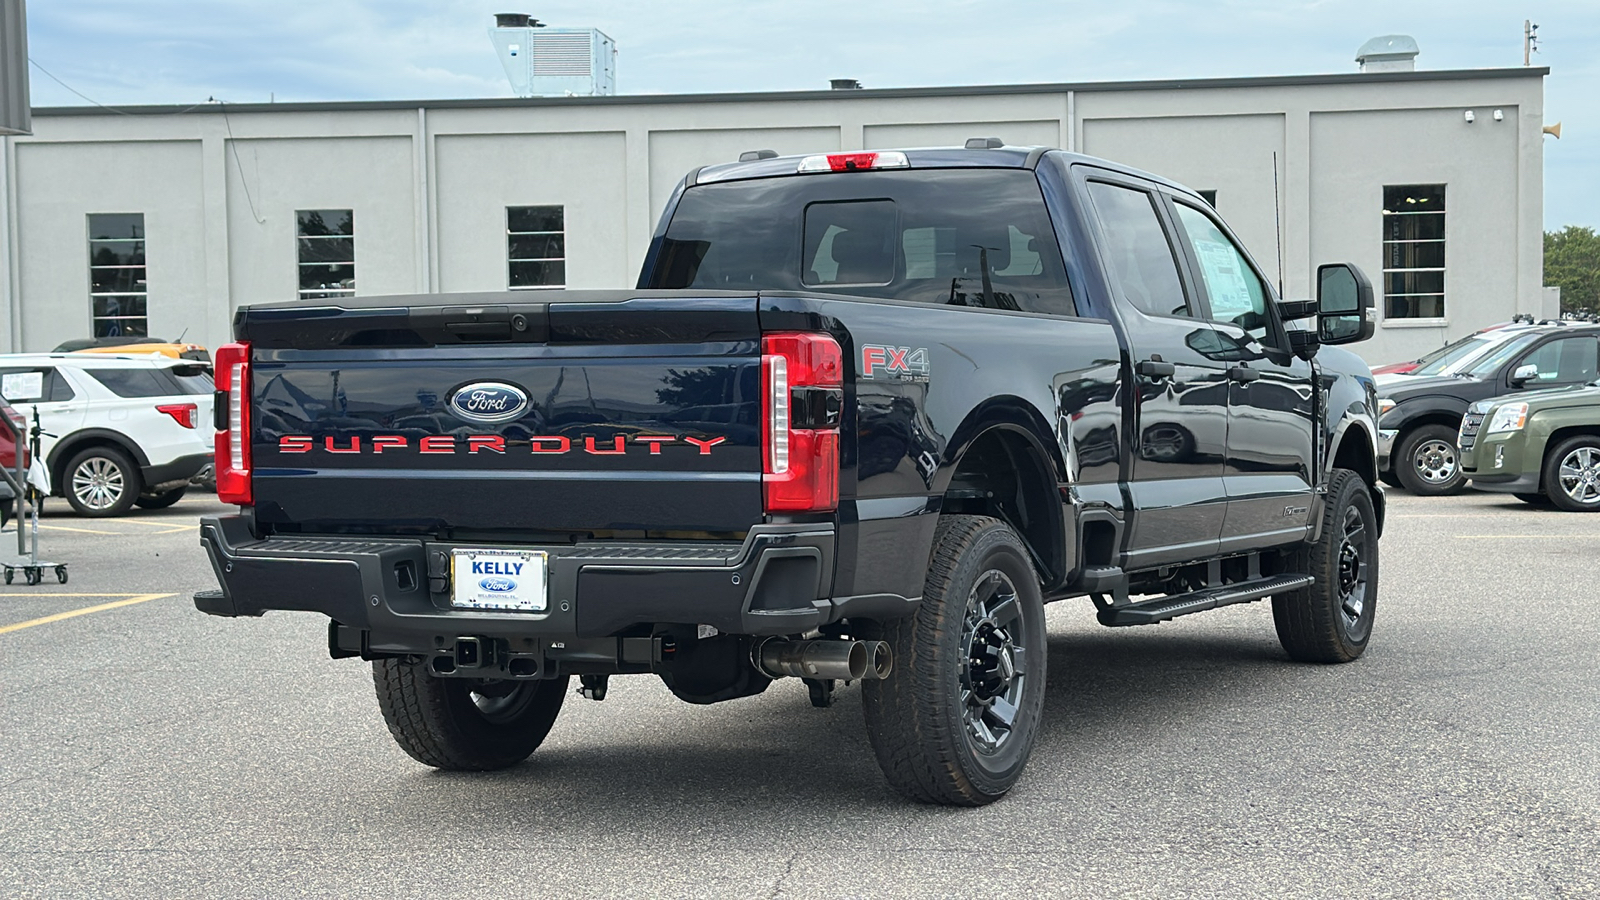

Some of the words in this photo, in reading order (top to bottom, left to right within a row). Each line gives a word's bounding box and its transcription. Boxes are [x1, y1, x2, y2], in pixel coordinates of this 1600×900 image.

[862, 344, 930, 379] FX4
[467, 390, 508, 410] Ford
[279, 435, 506, 454] SUPER
[530, 435, 726, 455] DUTY
[472, 561, 523, 575] KELLY
[486, 579, 509, 590] Ford
